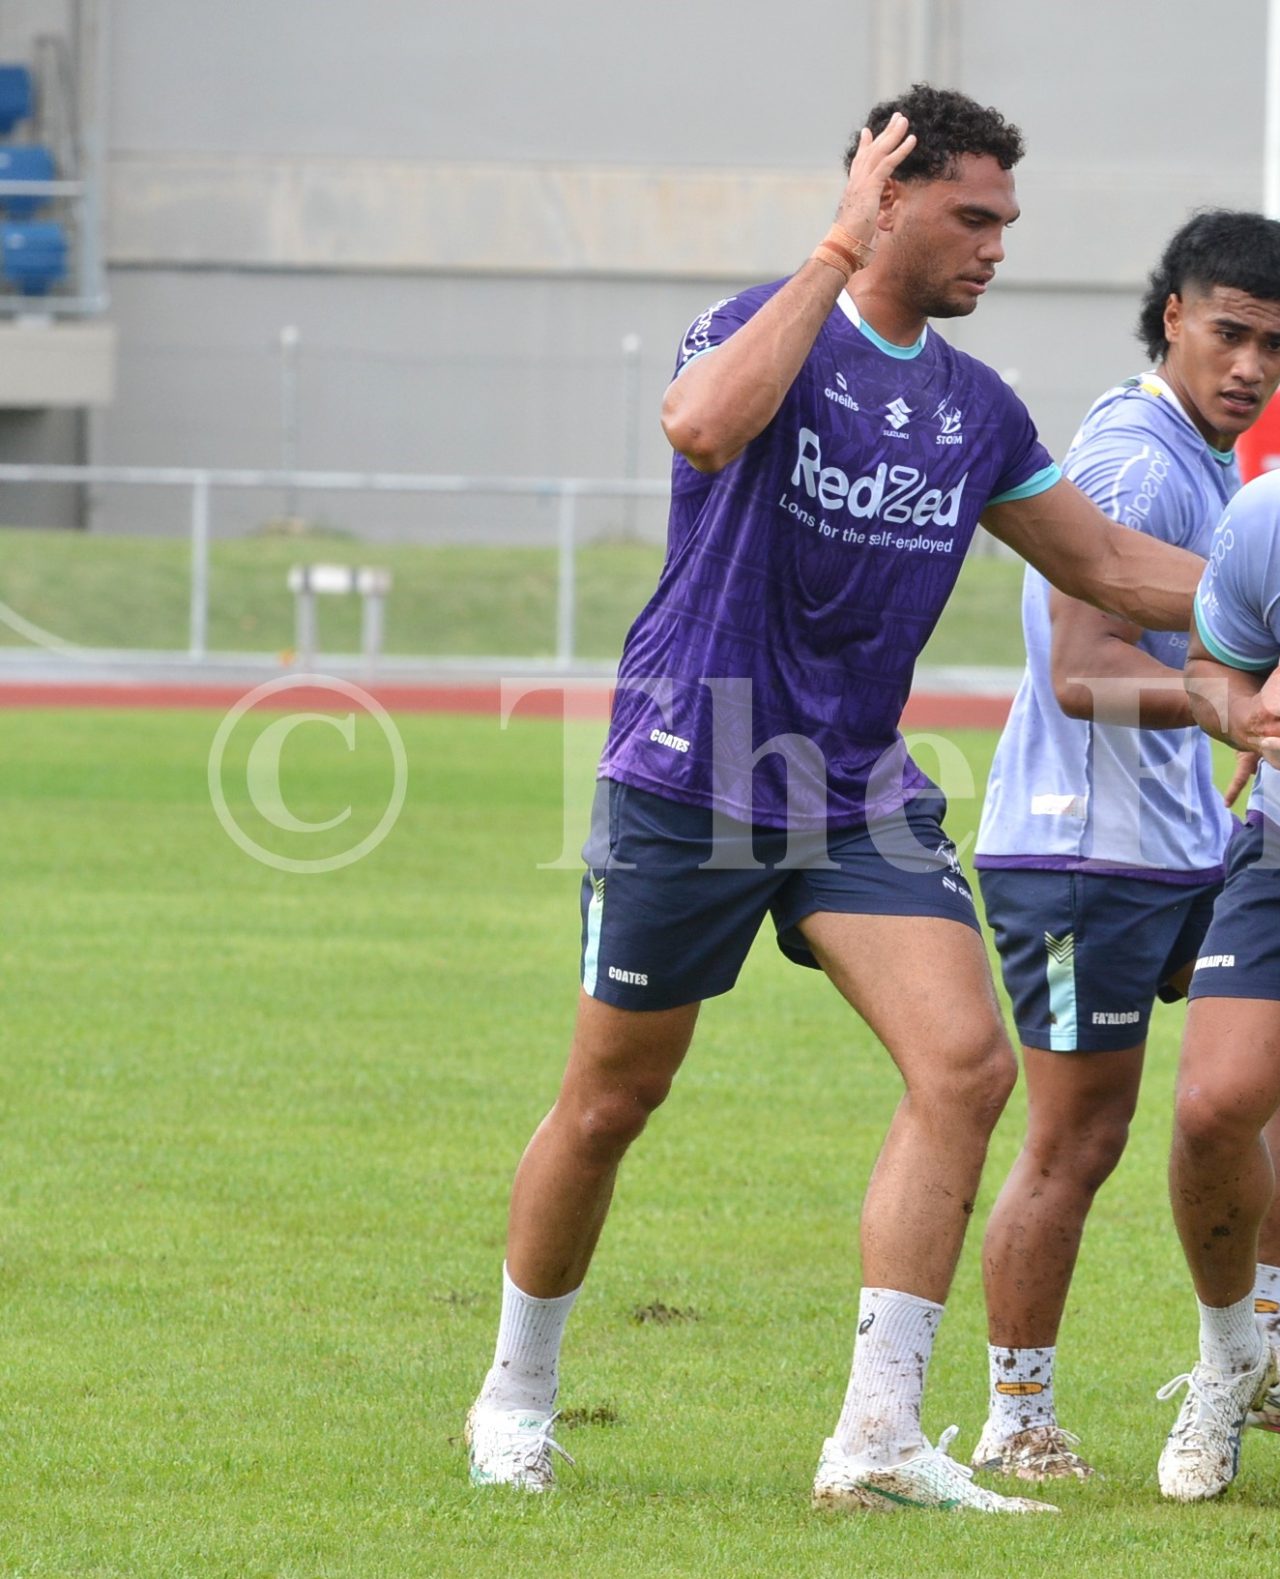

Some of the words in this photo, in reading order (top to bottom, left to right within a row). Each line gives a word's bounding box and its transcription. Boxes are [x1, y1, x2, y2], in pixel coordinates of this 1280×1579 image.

[818, 519, 840, 538] for
[842, 527, 866, 544] the
[650, 728, 690, 754] COATES
[608, 966, 648, 986] COATES
